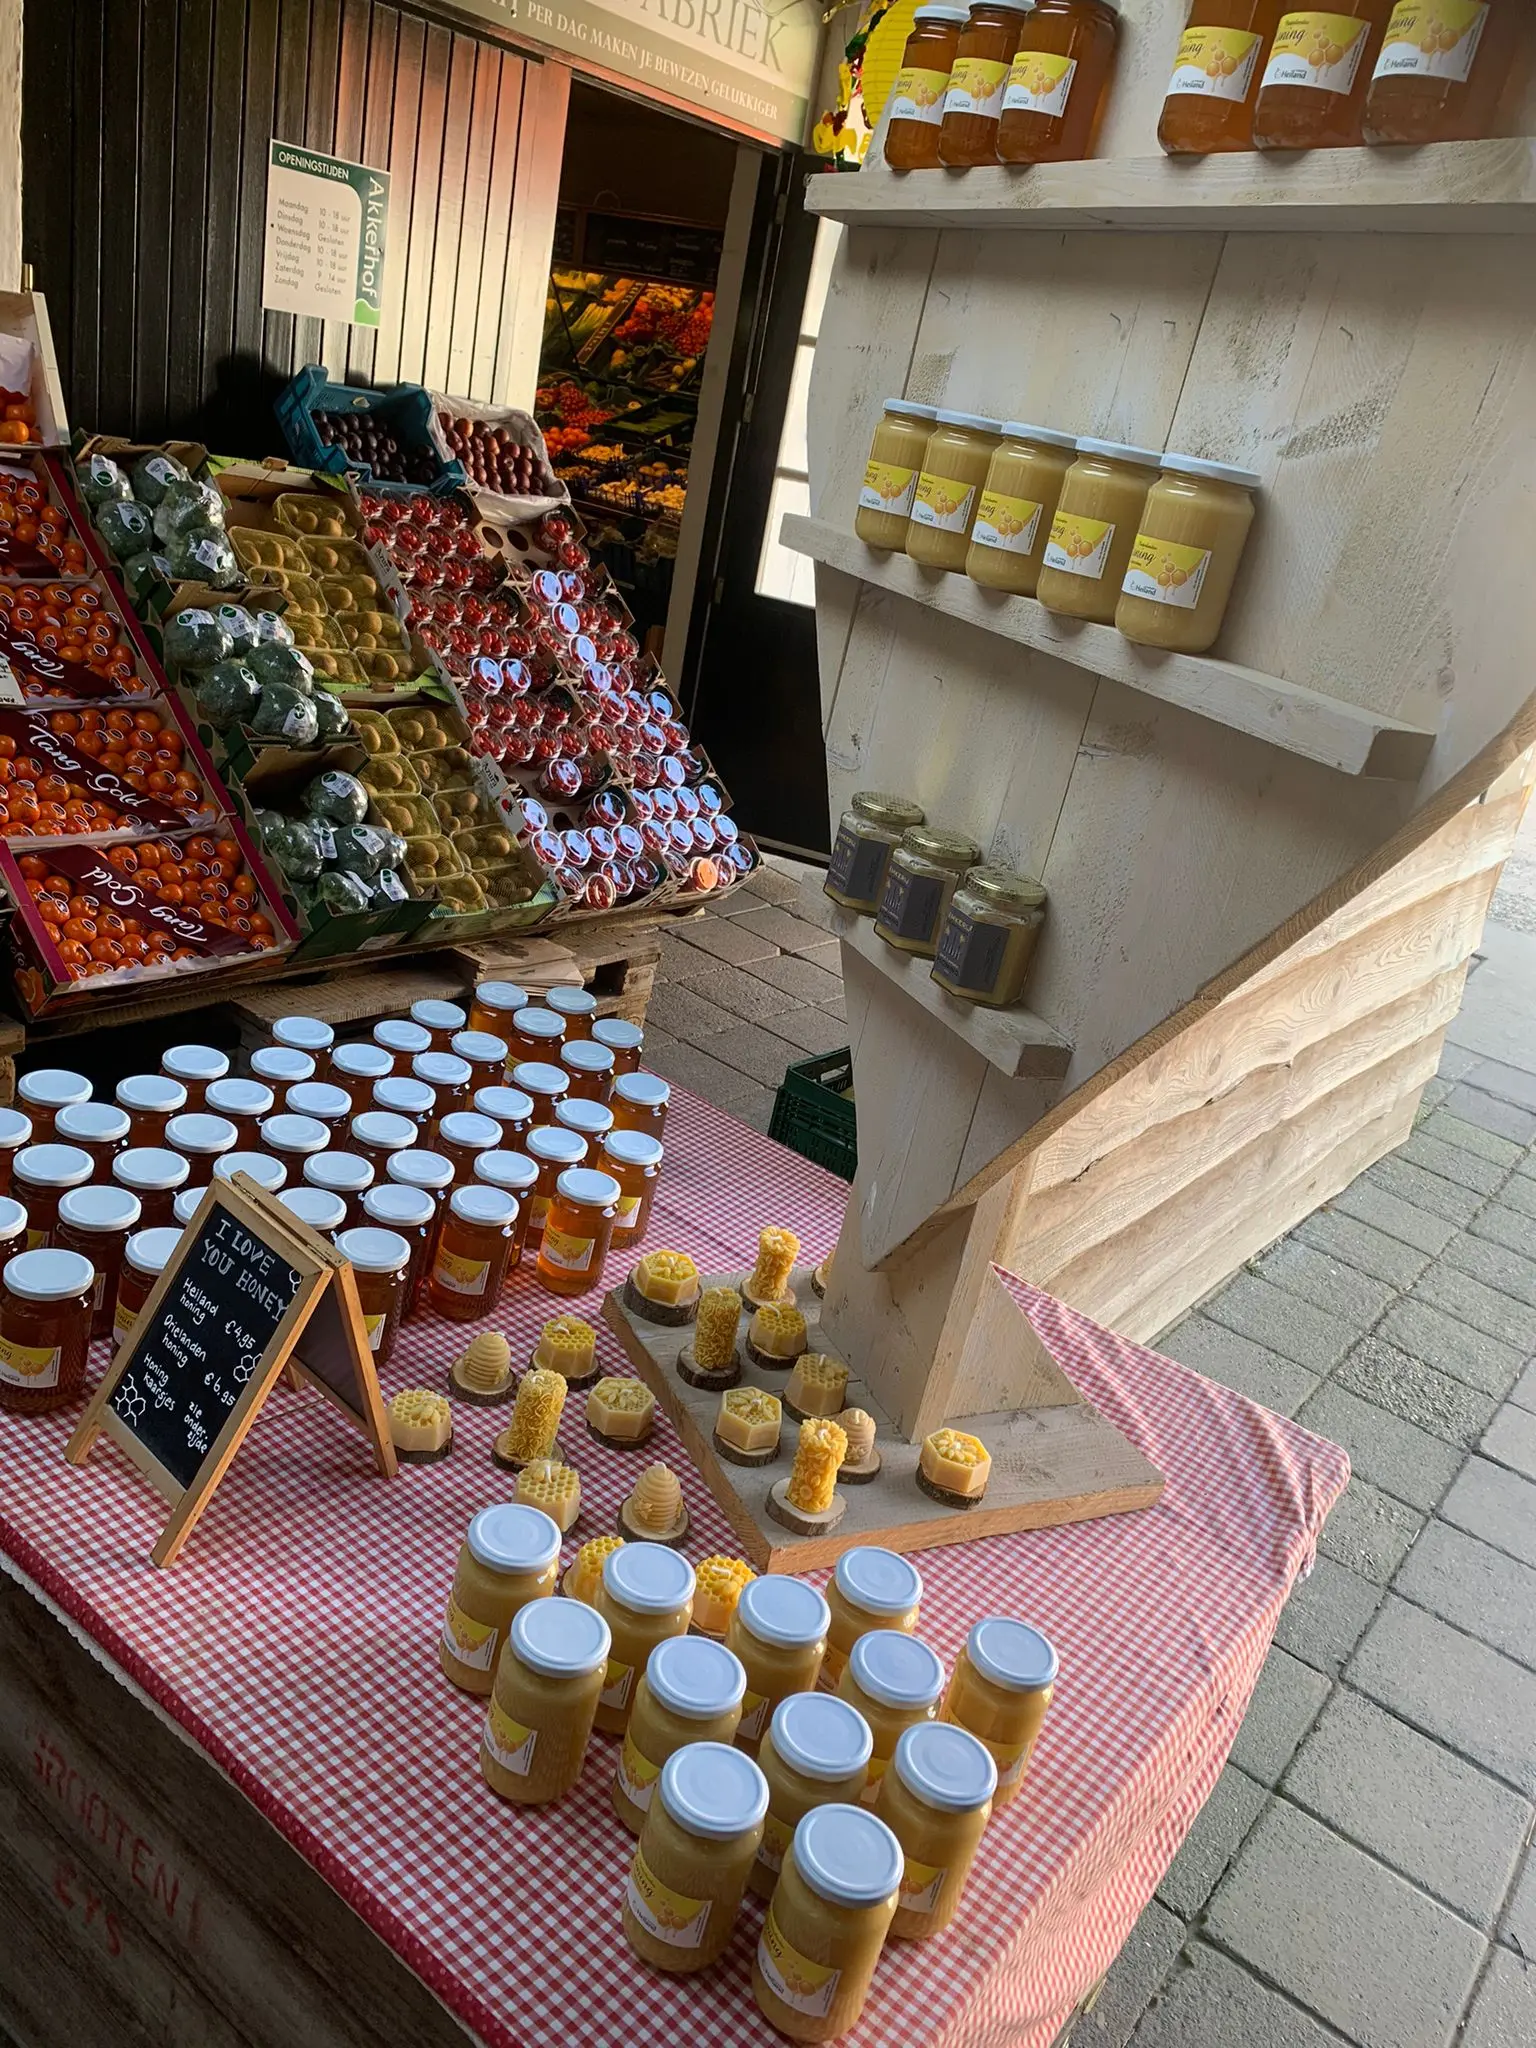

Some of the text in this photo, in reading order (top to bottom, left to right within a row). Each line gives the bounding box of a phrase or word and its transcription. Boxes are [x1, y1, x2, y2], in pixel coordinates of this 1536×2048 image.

[527, 2, 779, 122] PER DAG MAKEN JE BEWEZEN GELUKKIGER
[1281, 68, 1308, 79] Heiland
[278, 151, 350, 179] OPENINGSTIJDEN
[277, 210, 304, 226] Dinsdag
[318, 219, 326, 229] 10
[278, 198, 309, 215] Maandag
[319, 207, 327, 217] 10
[276, 235, 311, 254] Donderdag
[317, 245, 325, 254] 10
[277, 223, 345, 246] Woensdag Gesloten
[362, 176, 385, 299] Akkerhof
[275, 249, 300, 264] Vrijdag
[316, 257, 324, 267] 10
[275, 262, 305, 278] Zaterdag
[274, 275, 342, 296] Zondag Gesloten
[215, 1218, 275, 1276] I LOVE
[201, 1238, 289, 1322] YOU HONEY
[182, 1277, 219, 1317] Heiland
[179, 1294, 206, 1326] honing
[162, 1314, 207, 1362] Drielanden
[161, 1333, 189, 1369] honing
[143, 1352, 169, 1388] Honing
[188, 1401, 203, 1419] zie
[187, 1432, 208, 1455] zijde
